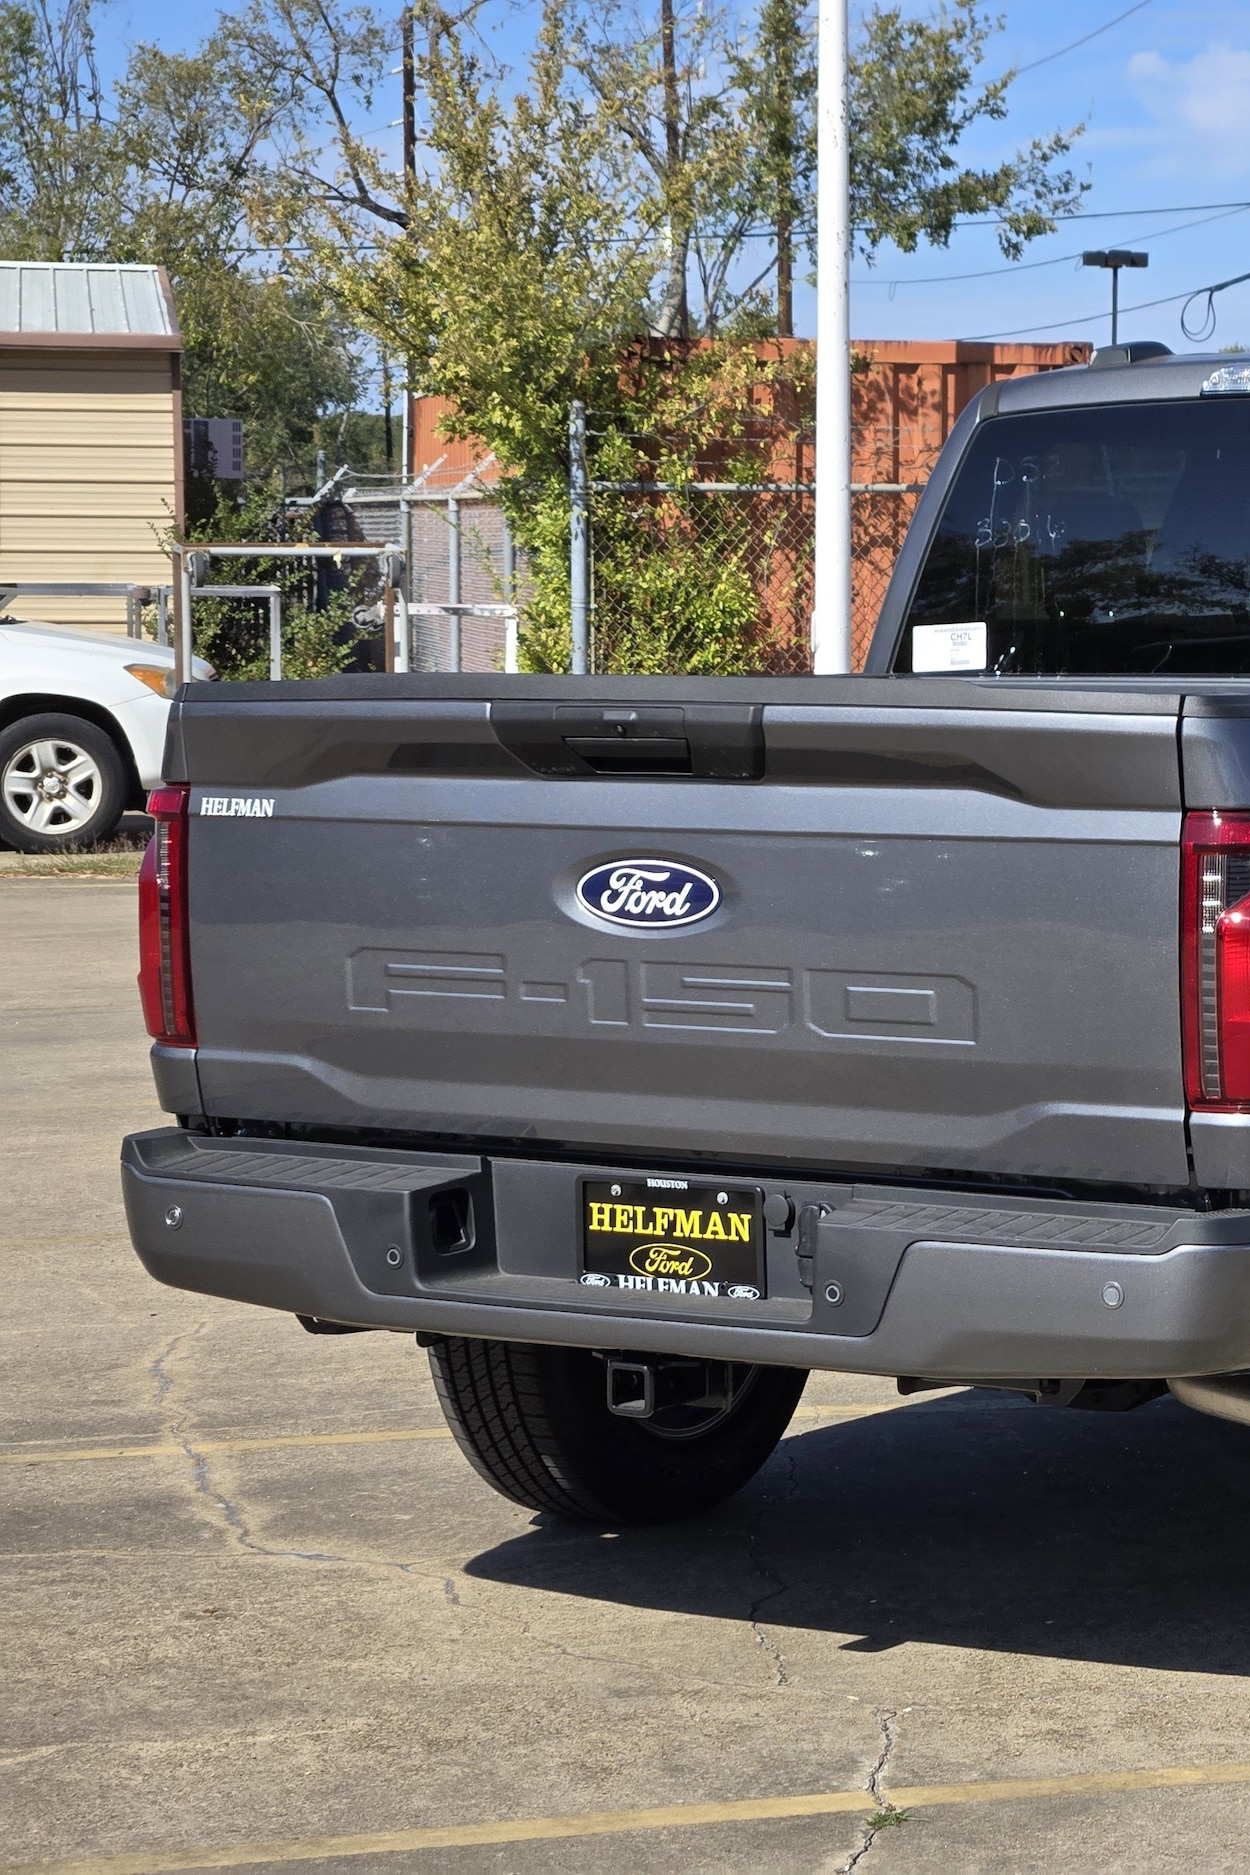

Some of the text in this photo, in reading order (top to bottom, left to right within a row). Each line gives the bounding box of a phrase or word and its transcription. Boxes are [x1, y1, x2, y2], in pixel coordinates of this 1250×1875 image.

[200, 797, 275, 818] HELFMAN
[600, 868, 693, 916] Ford
[346, 947, 979, 1045] F-150
[647, 1178, 688, 1190] HOUSTON
[588, 1202, 752, 1242] HELFMAN
[645, 1247, 694, 1276] Ford
[617, 1275, 720, 1297] HELFMAN
